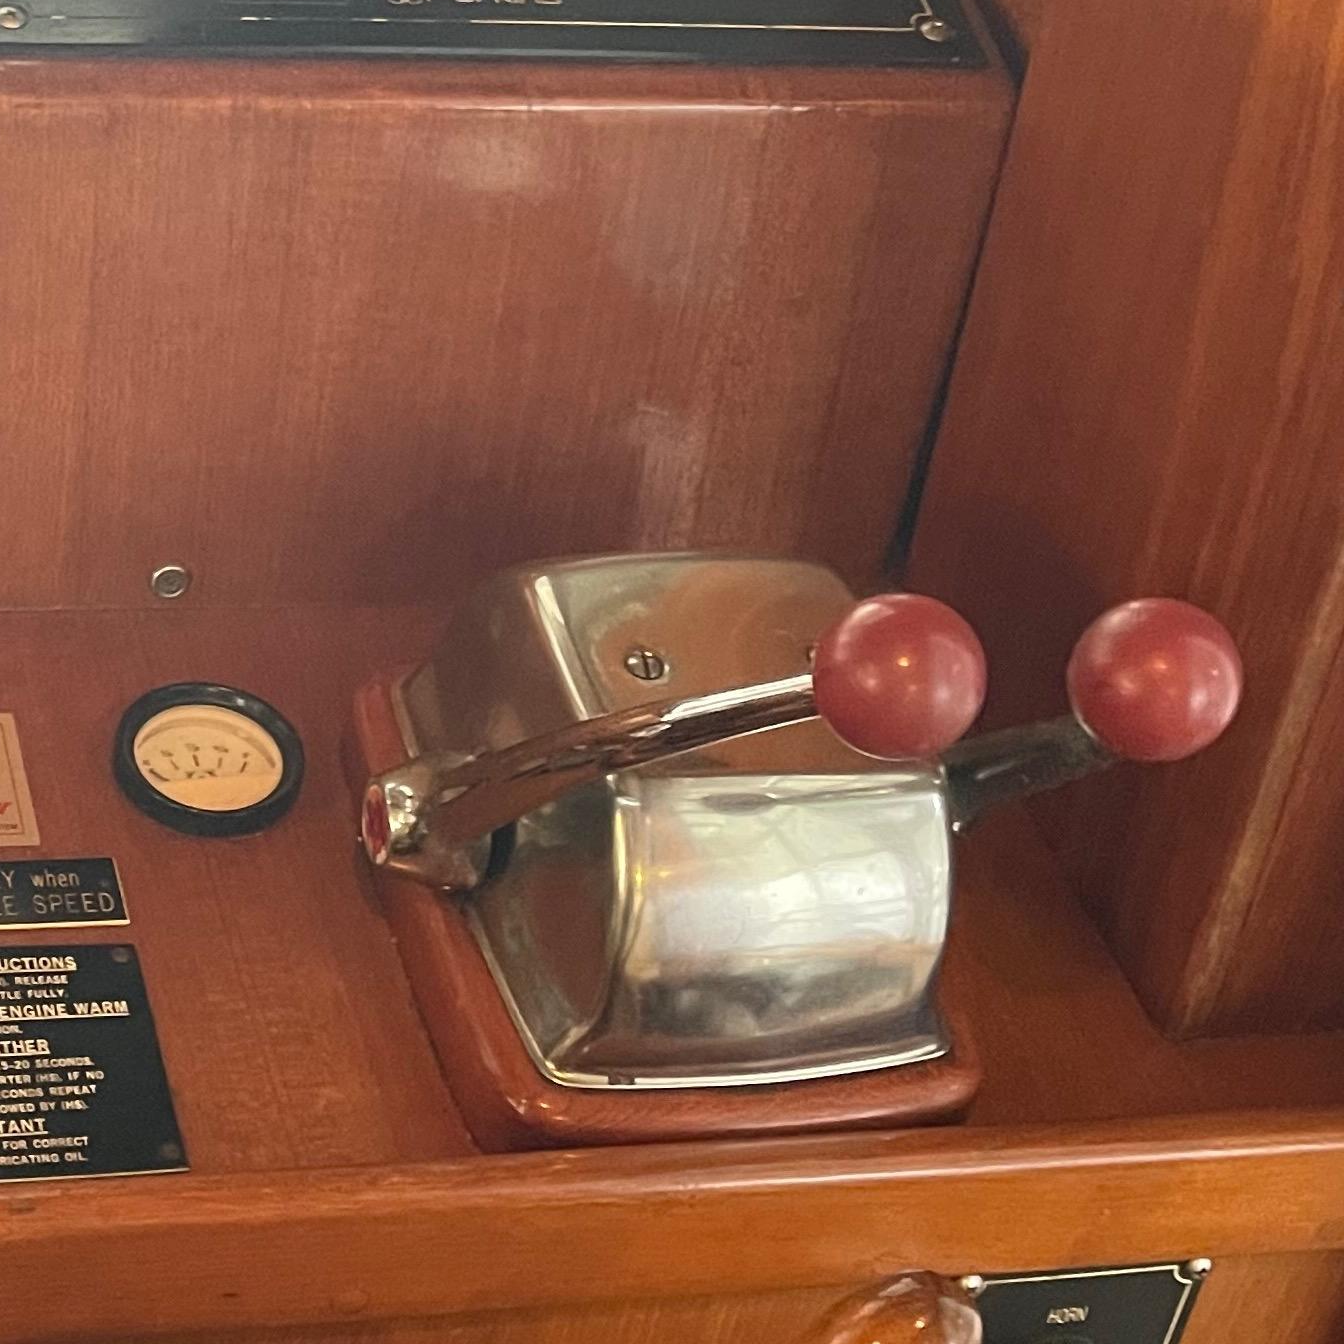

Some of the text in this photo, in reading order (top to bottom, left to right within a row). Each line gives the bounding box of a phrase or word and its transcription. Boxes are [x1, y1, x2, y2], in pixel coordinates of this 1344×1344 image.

[30, 868, 80, 888] when
[32, 892, 115, 914] SPEED
[14, 975, 68, 985] RELEASE
[73, 1000, 129, 1015] WARM
[67, 1071, 80, 1081] IF
[85, 1070, 105, 1080] NO
[49, 1084, 97, 1096] REPEAT
[39, 1101, 56, 1111] BY
[2, 1140, 28, 1150] FOR
[32, 1136, 89, 1148] CORRECT
